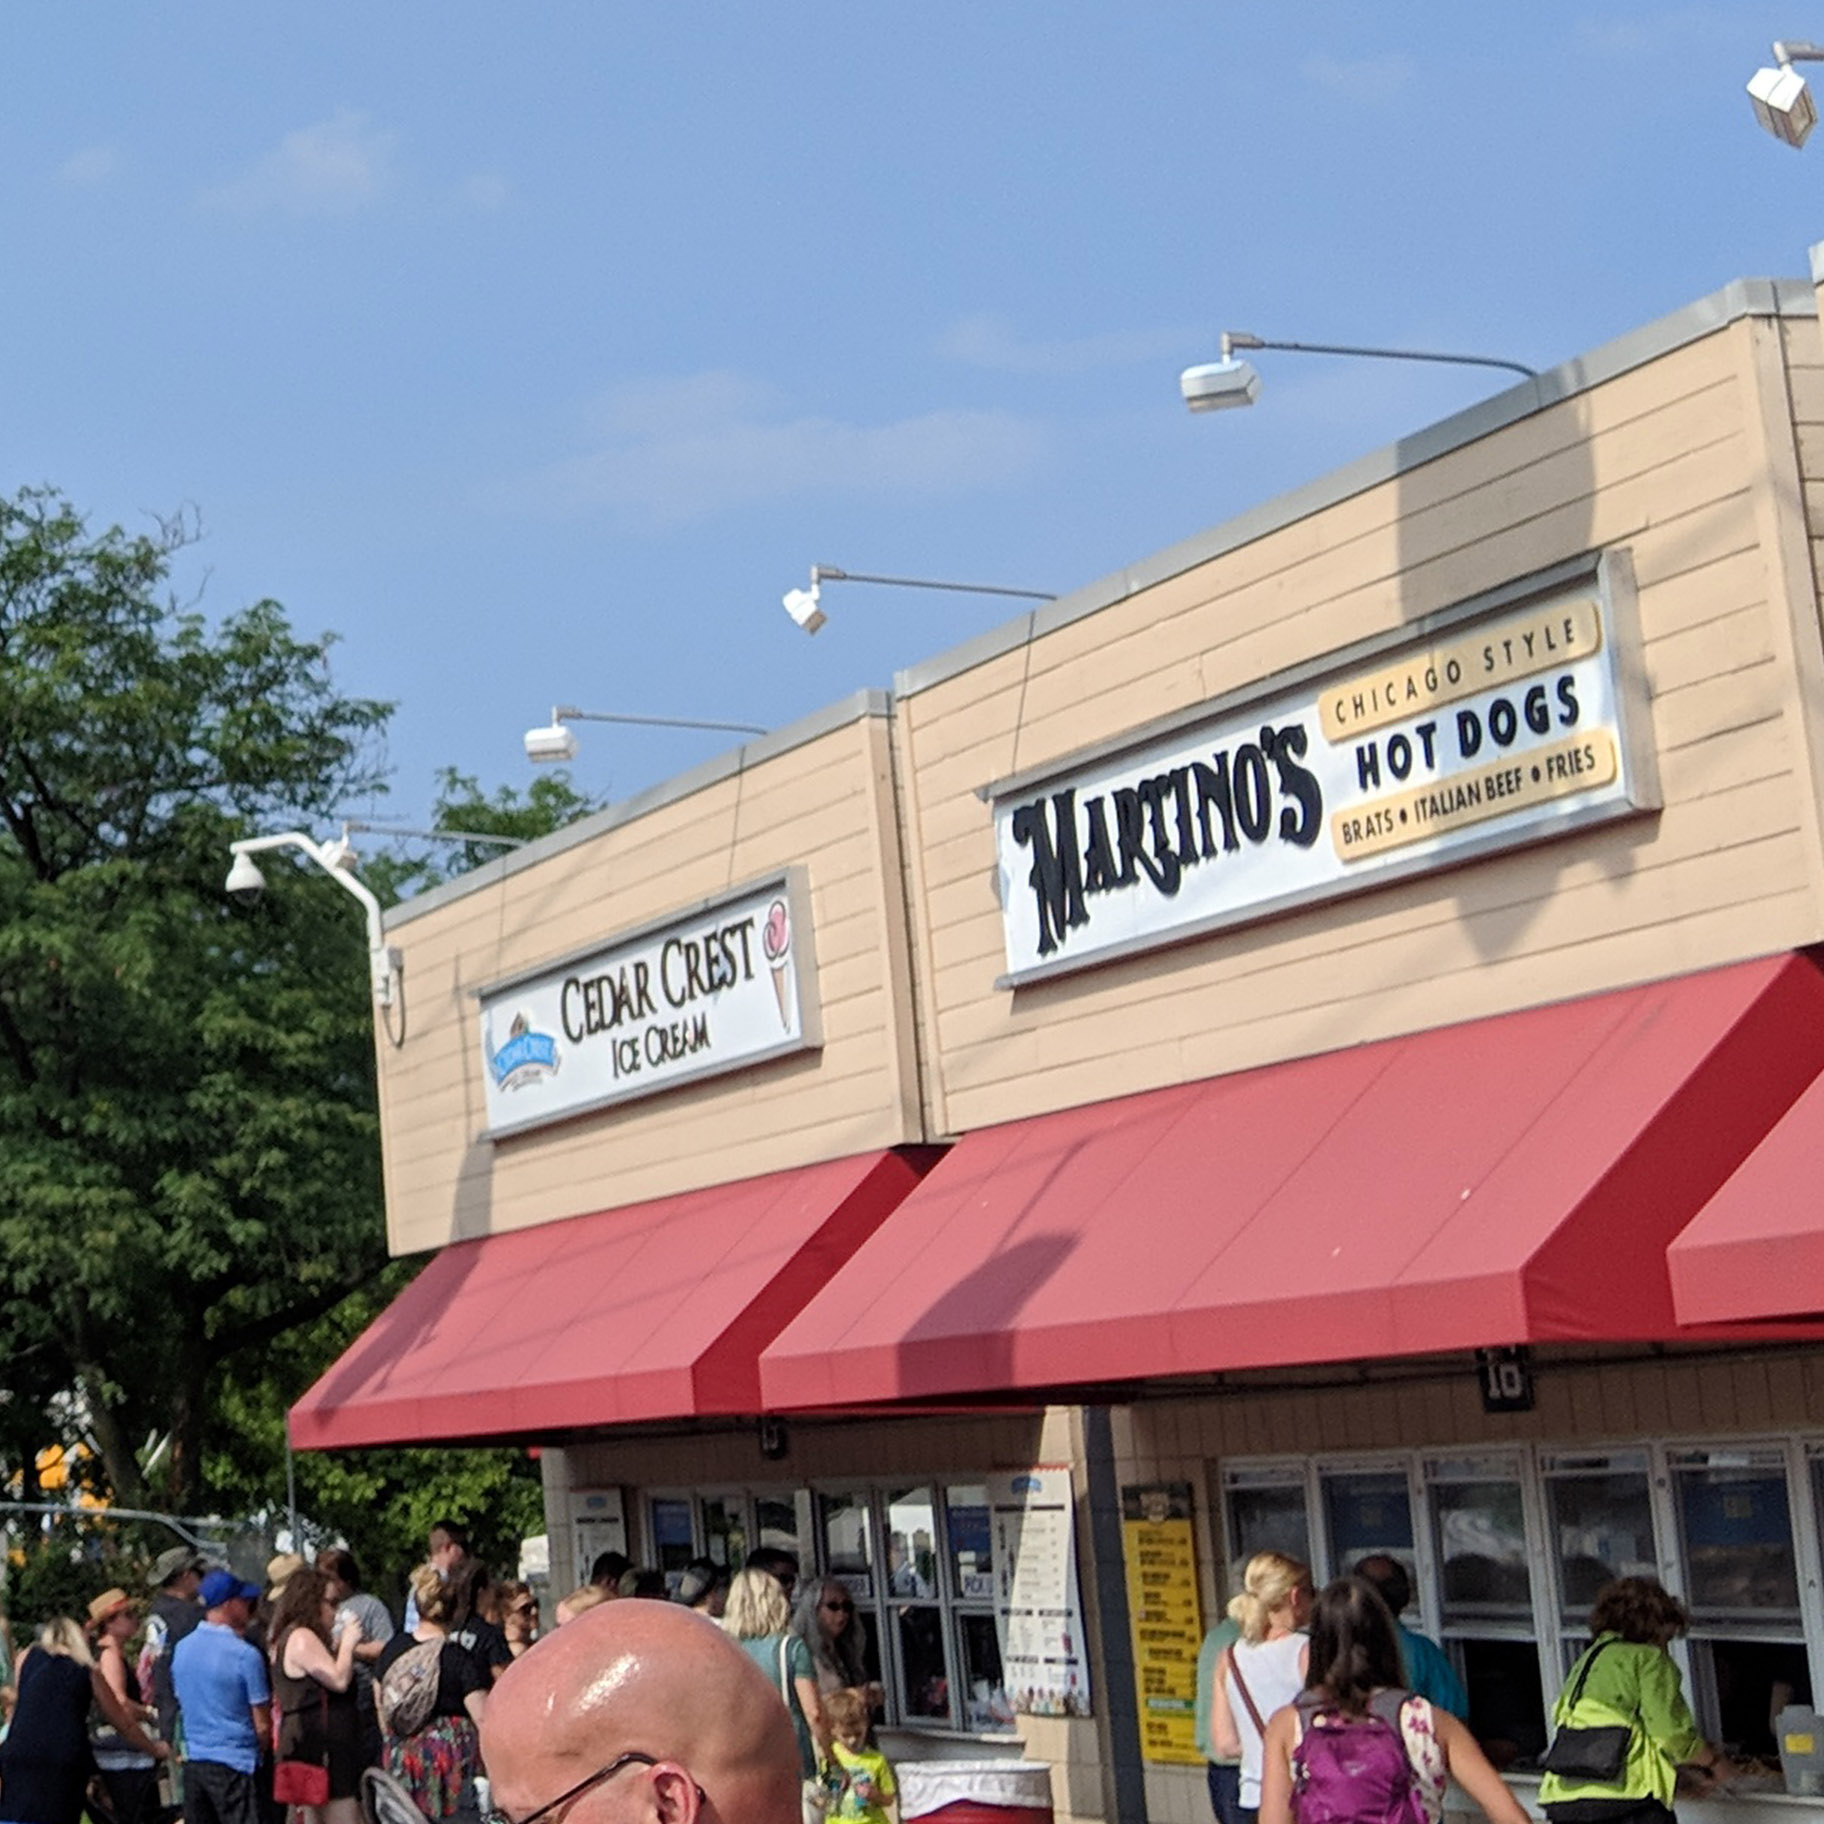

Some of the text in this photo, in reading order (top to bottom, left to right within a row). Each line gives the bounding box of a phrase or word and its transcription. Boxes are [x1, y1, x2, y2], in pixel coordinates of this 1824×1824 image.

[1334, 617, 1577, 726] CHICAGO STYLE
[1355, 675, 1581, 791] HOT DOGS
[1012, 722, 1324, 958] MARTINO'S
[1341, 746, 1597, 845] BRATS ITALIAN BEEF FRIES
[560, 916, 756, 1044] CEDAR CREST
[611, 1011, 712, 1079] ICE CREAM
[1488, 1363, 1522, 1399] 10
